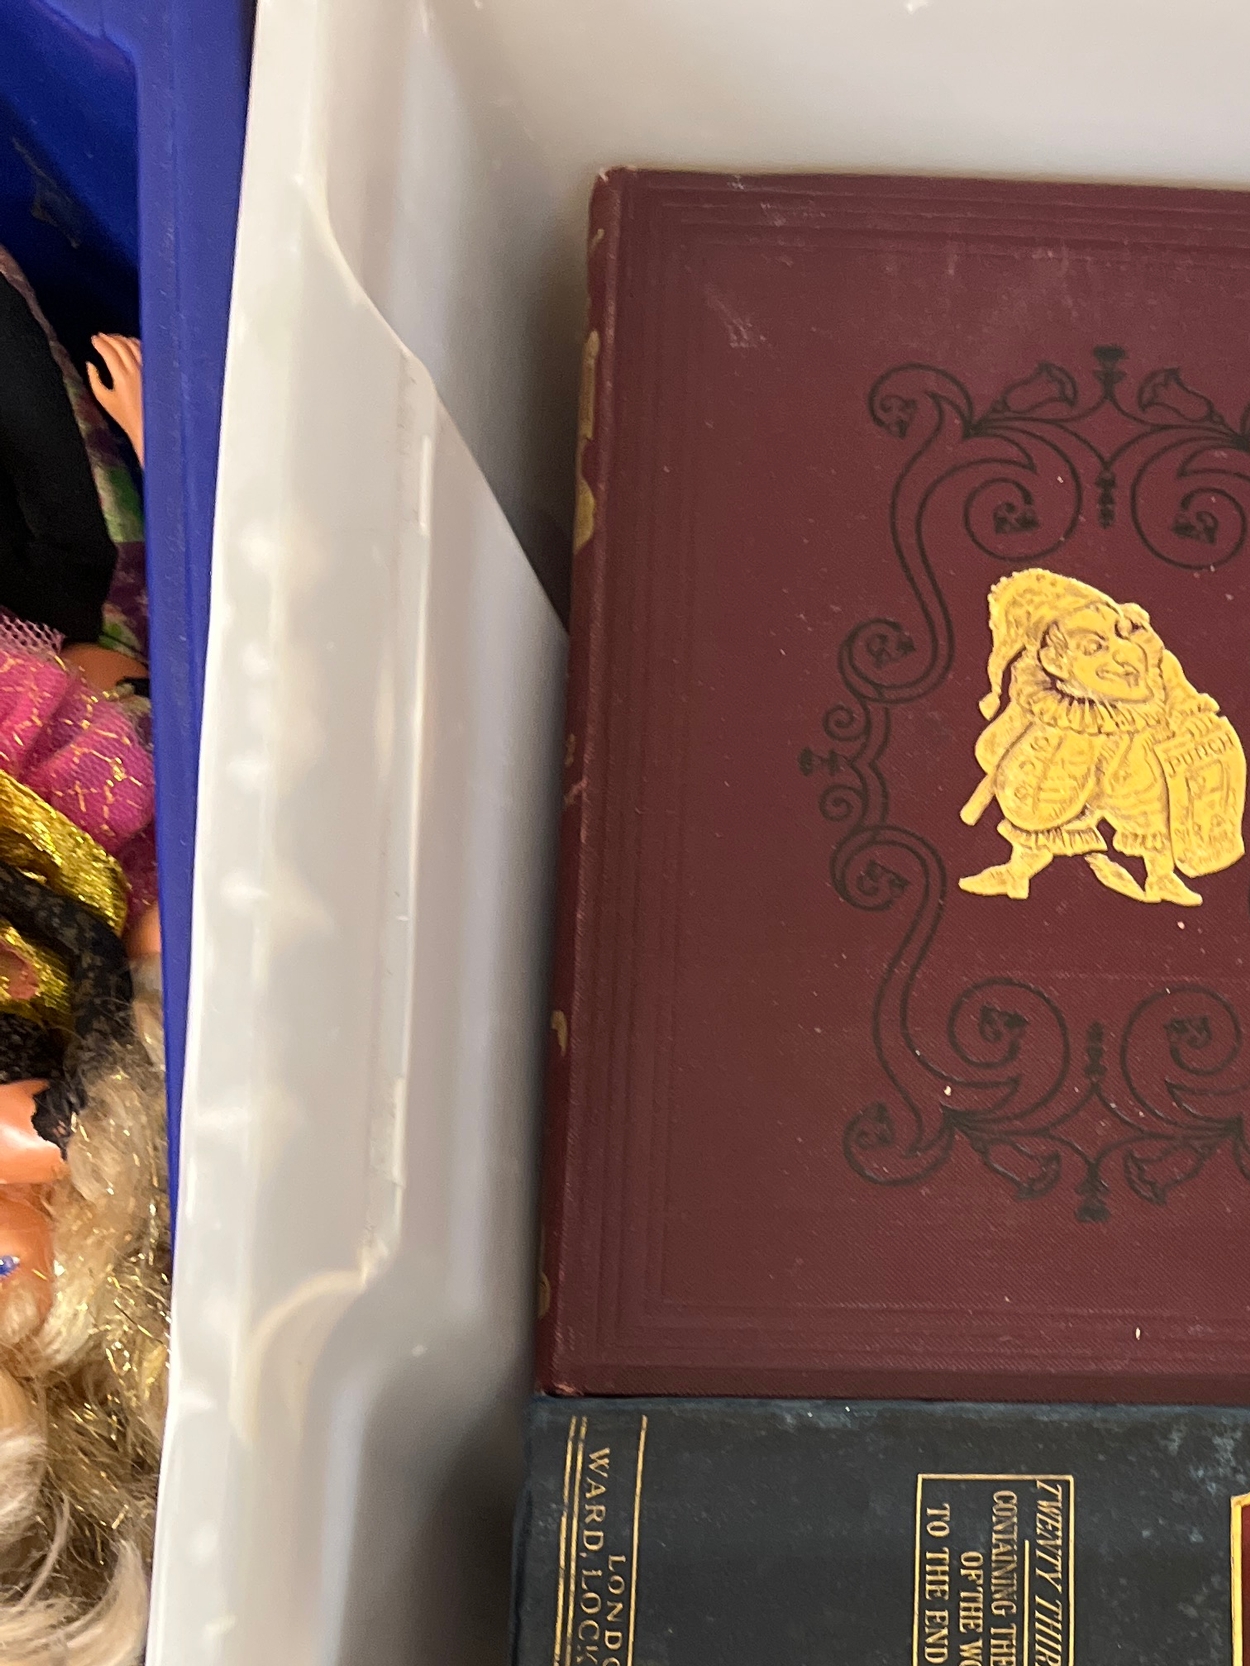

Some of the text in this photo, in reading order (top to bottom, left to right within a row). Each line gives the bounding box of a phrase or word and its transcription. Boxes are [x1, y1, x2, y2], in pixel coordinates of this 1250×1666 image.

[580, 1446, 612, 1558] WARD,
[925, 1502, 951, 1539] TO
[990, 1489, 1019, 1618] CONTAINING
[1035, 1479, 1064, 1593] TWENTY
[924, 1547, 950, 1602] THE
[958, 1550, 984, 1583] OF
[575, 1568, 603, 1663] LOCK
[923, 1608, 949, 1665] END
[958, 1584, 984, 1634] THE
